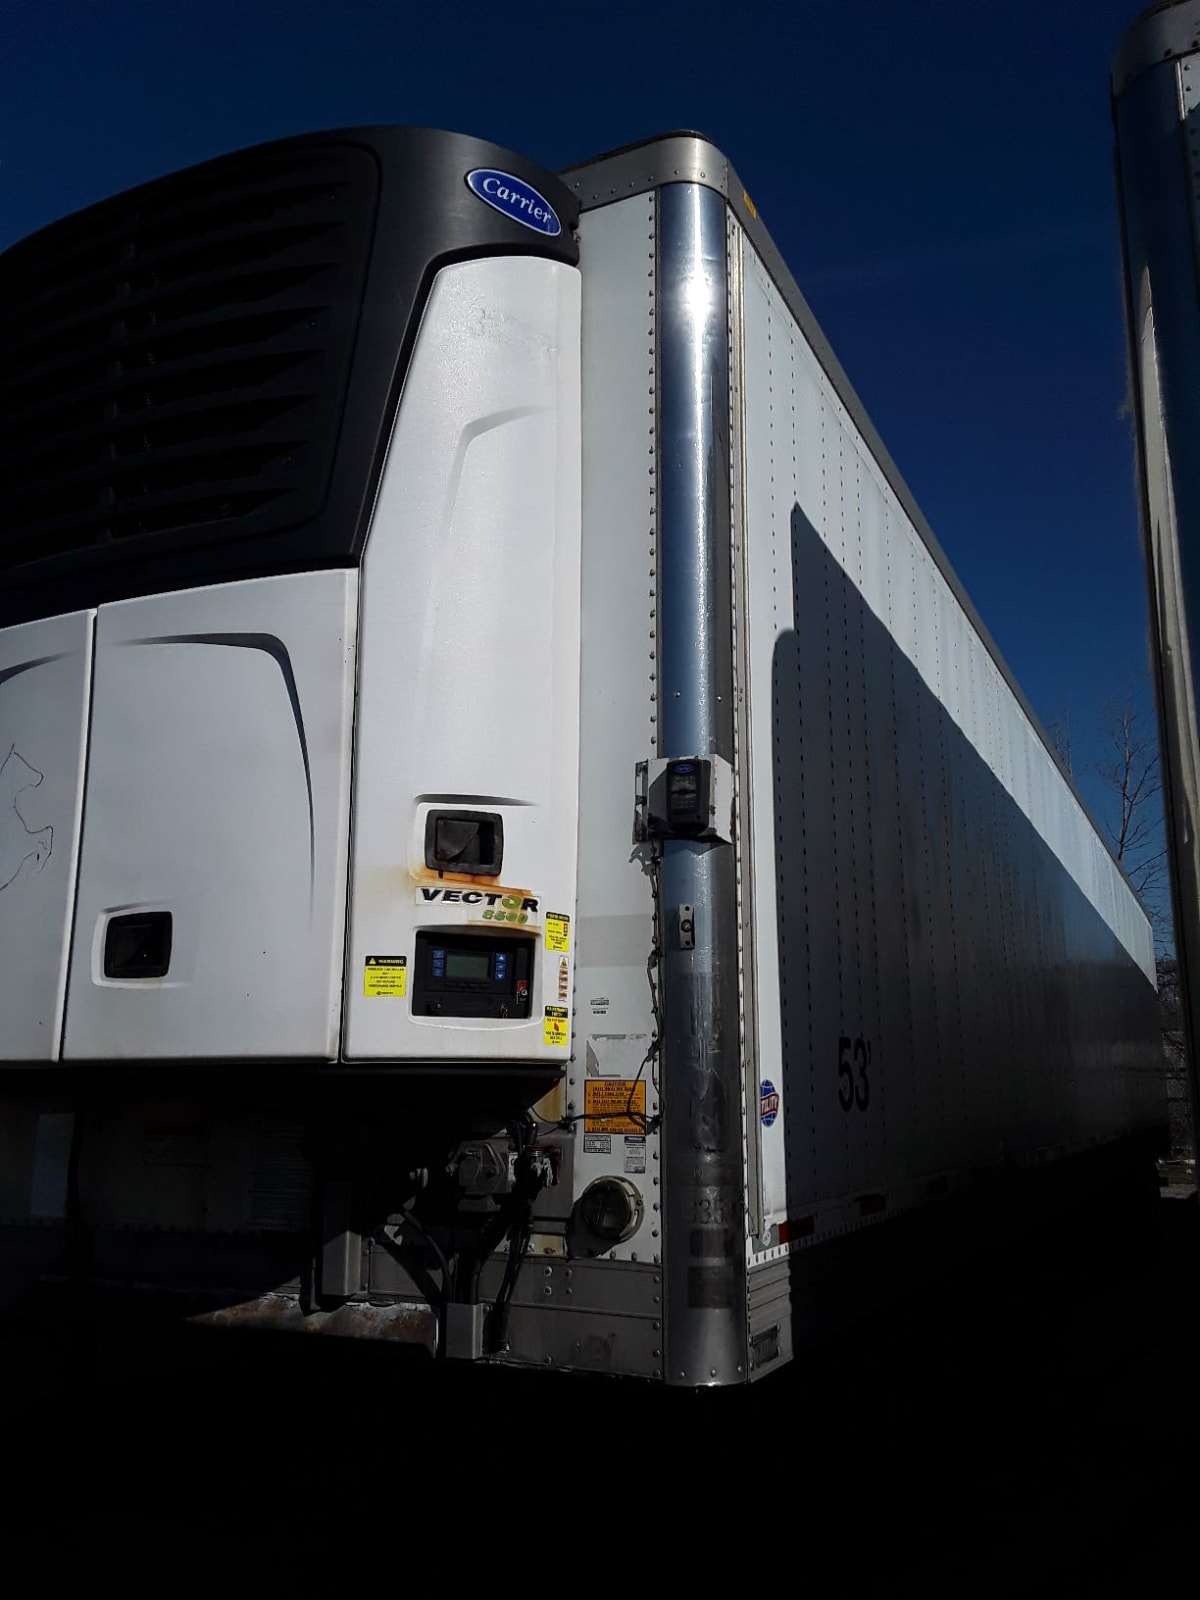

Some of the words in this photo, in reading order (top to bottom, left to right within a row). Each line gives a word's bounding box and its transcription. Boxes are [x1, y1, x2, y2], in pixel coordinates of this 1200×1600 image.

[482, 177, 552, 224] Carrier
[420, 887, 539, 913] VECTOR
[760, 1094, 779, 1115] TILITY
